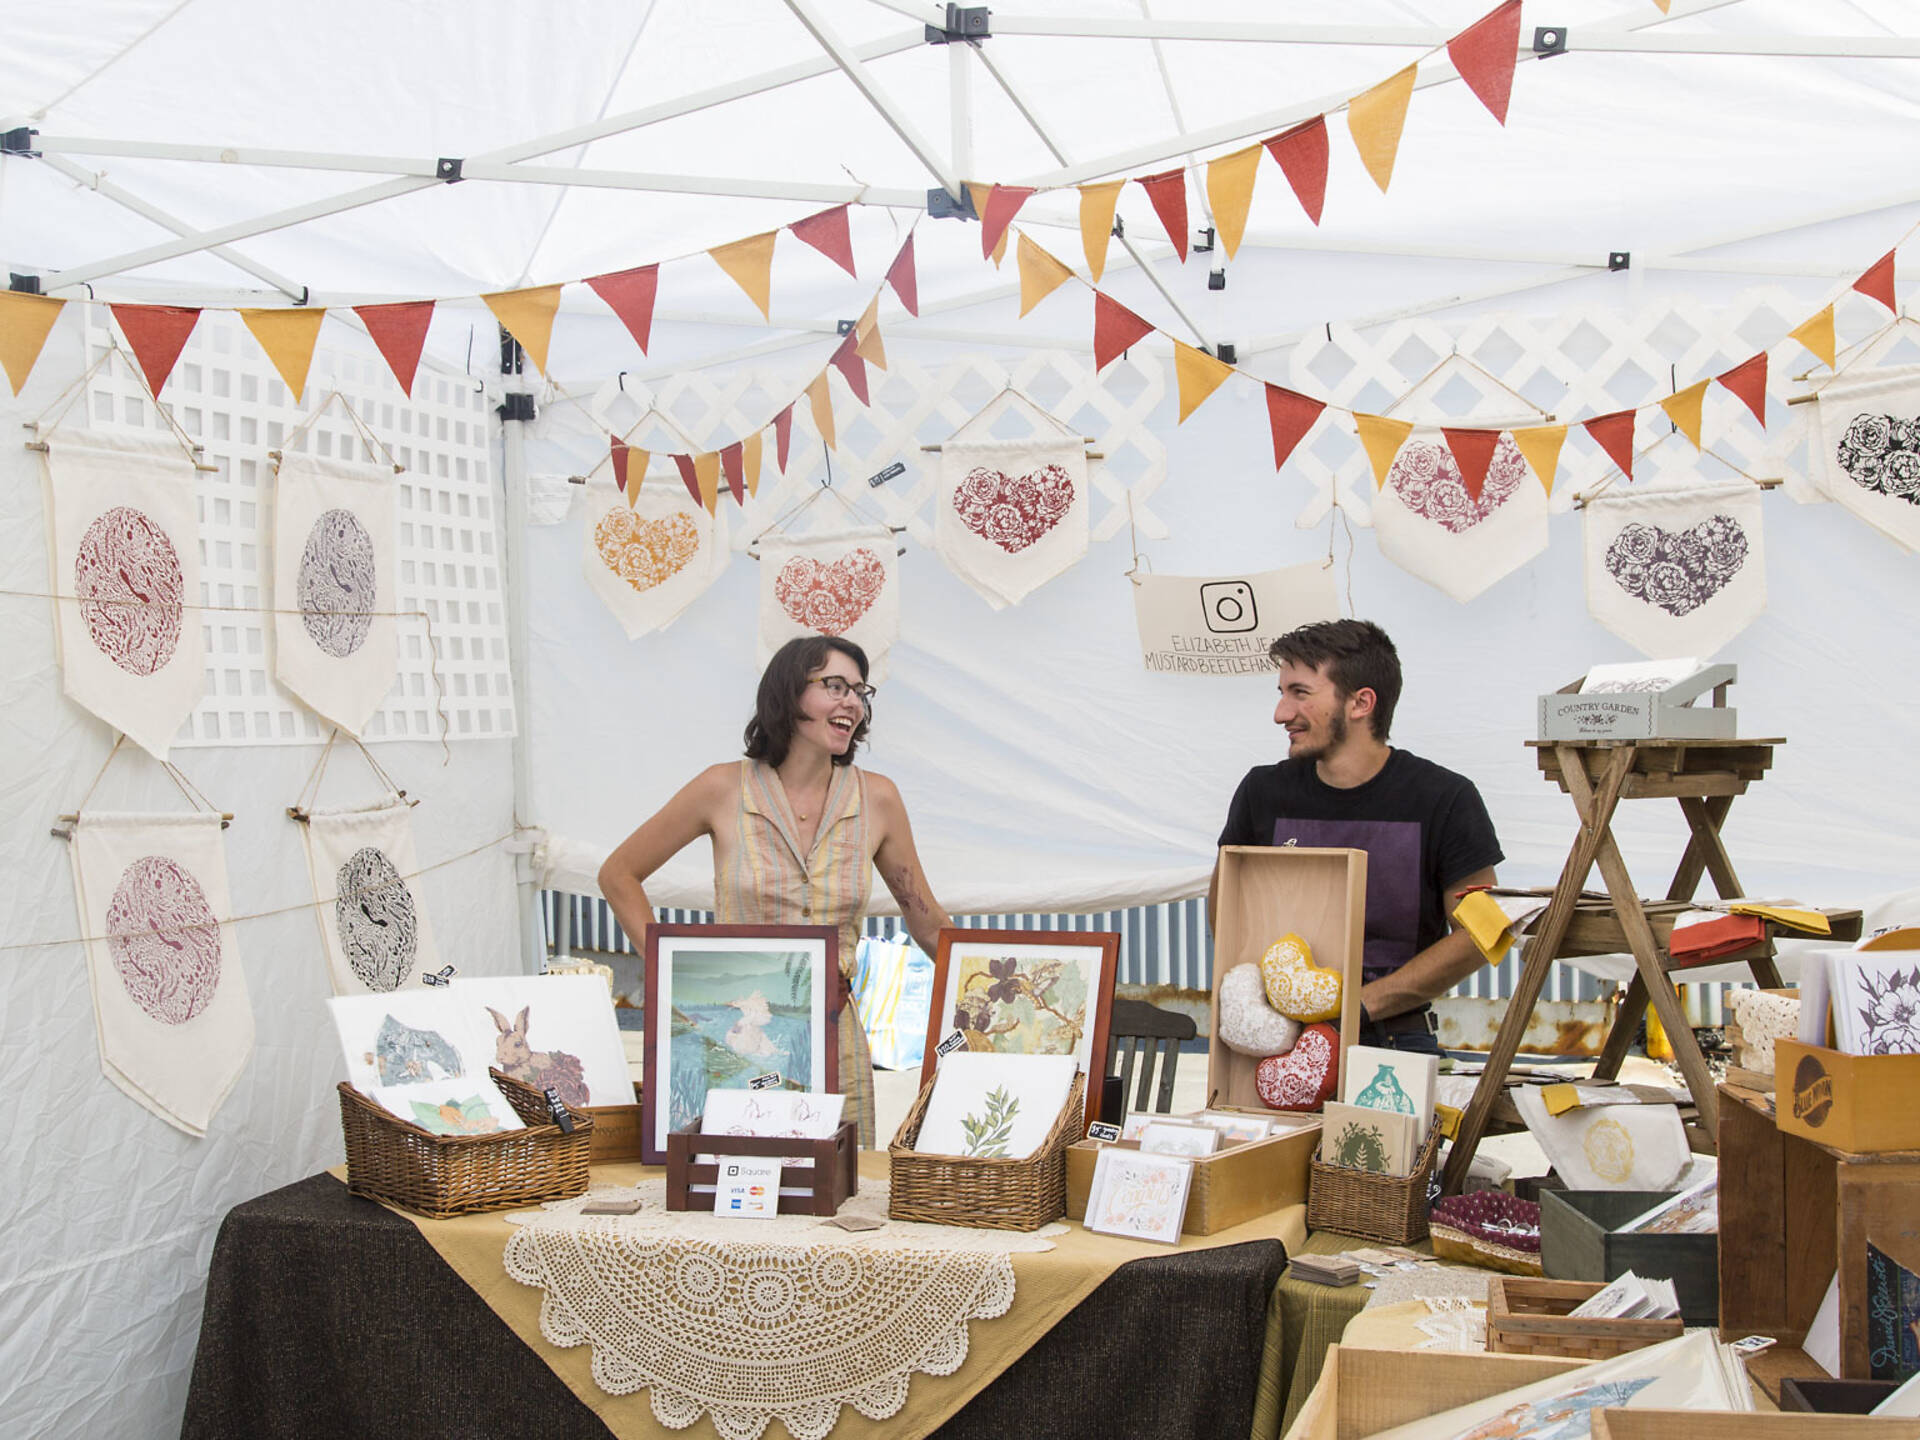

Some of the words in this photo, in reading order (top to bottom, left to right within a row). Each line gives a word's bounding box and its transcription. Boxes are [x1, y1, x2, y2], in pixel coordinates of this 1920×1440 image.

[1171, 635, 1251, 654] ELIZABETH
[1558, 703, 1600, 716] COUNTRY
[1602, 703, 1639, 715] GARDEN
[741, 1167, 771, 1176] Square
